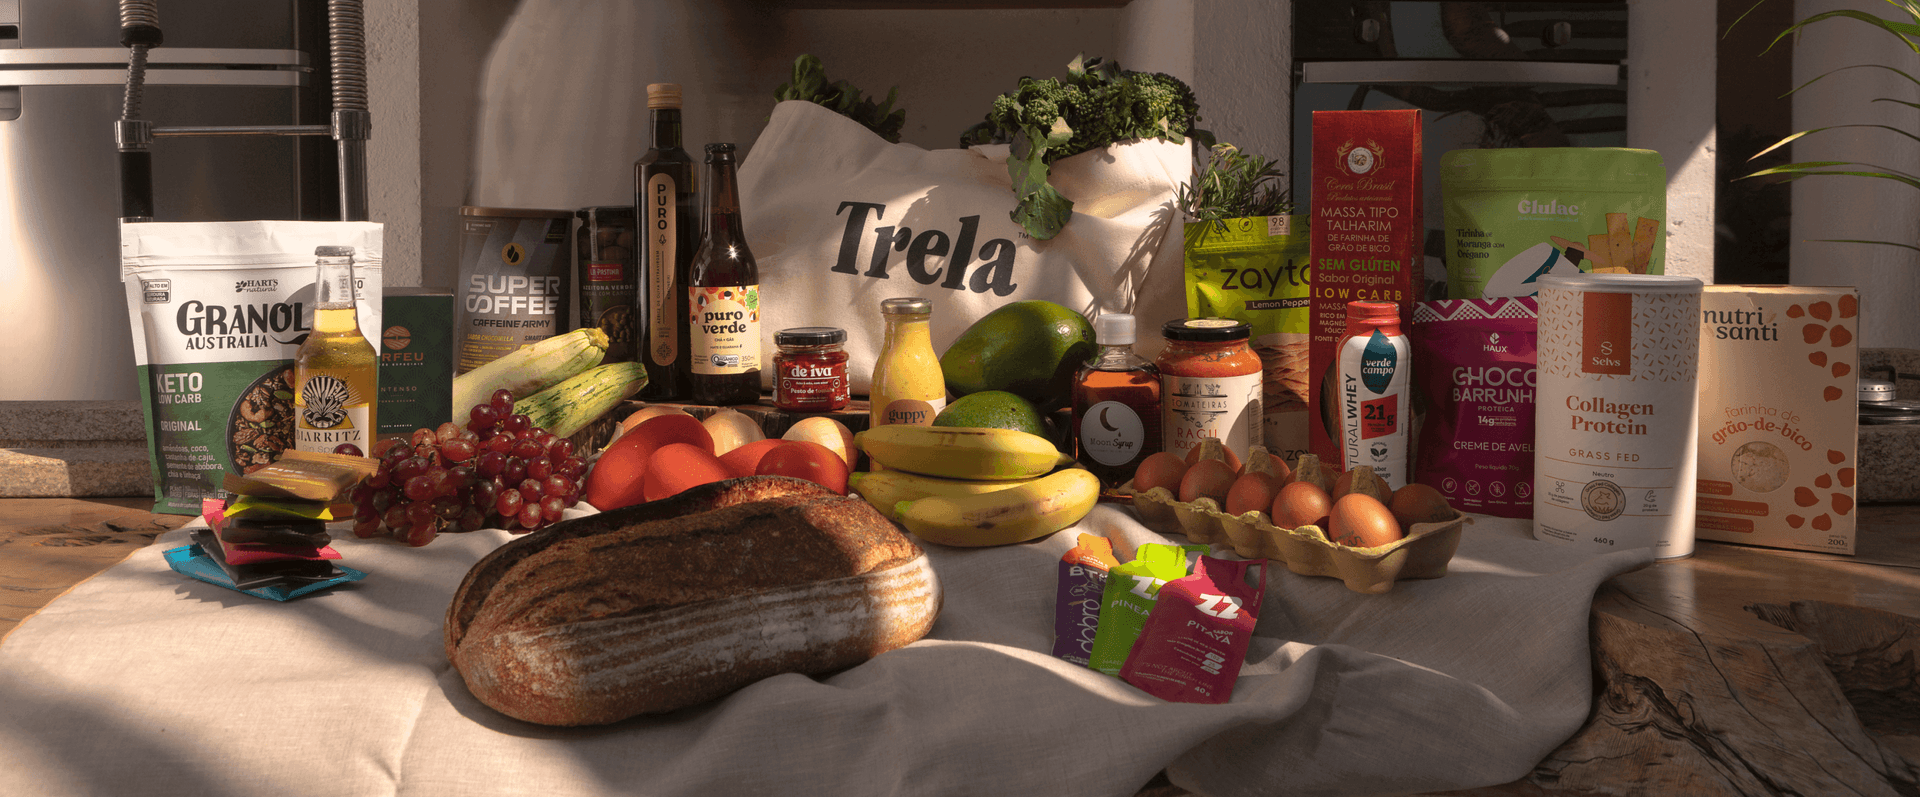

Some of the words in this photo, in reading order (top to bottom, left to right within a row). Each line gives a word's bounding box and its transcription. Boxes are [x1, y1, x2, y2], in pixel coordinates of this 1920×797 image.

[1357, 177, 1395, 190] Brasil
[657, 183, 667, 230] PURO
[1321, 207, 1366, 218] MASSA
[1370, 207, 1398, 218] TIPO
[1518, 199, 1579, 216] Glulac
[1327, 220, 1392, 231] TALHARIM
[1340, 234, 1375, 242] FARINHA
[1456, 229, 1485, 238] Tirinha
[831, 201, 1017, 297] Trela
[1328, 243, 1354, 252] GRÃO
[1457, 239, 1492, 249] Moranga
[1319, 258, 1345, 270] SEM
[1350, 256, 1400, 272] GLÚTEN
[469, 275, 560, 294] SUPER
[1319, 273, 1349, 283] Sabor
[1352, 274, 1395, 286] Original
[1316, 288, 1350, 299] LOW
[1357, 289, 1402, 300] CARB
[466, 295, 559, 315] COFFEE
[1252, 301, 1280, 309] Lemon
[1318, 302, 1347, 310] MASSA
[176, 300, 311, 336] GRANOL
[704, 311, 743, 323] puro
[1703, 307, 1764, 326] nutri
[473, 319, 520, 328] CAFFEINE
[522, 319, 550, 328] ARMY
[702, 321, 746, 334] verde
[1319, 319, 1347, 327] MAGNÉS
[1716, 323, 1778, 341] santi
[186, 335, 268, 350] AUSTRALIA
[382, 352, 424, 362] RFEU
[1365, 358, 1391, 367] verde
[1592, 357, 1621, 366] Selvs
[791, 365, 808, 377] de
[810, 364, 833, 377] iva
[1363, 366, 1394, 376] campo
[156, 372, 203, 393] KETO
[158, 394, 173, 404] LOW
[174, 393, 202, 404] CARB
[1453, 388, 1537, 405] BARRINH
[1172, 398, 1227, 408] TOMATEIRAS
[1566, 395, 1654, 419] Collagen
[889, 409, 928, 423] guppy
[1725, 403, 1777, 419] farinha
[1781, 410, 1800, 424] de
[160, 420, 202, 432] ORIGINAL
[1477, 416, 1495, 426] 14g
[1571, 415, 1648, 435] Protein
[296, 430, 361, 442] BIARRITZ
[1712, 417, 1812, 451] grão-de-bico
[1090, 438, 1111, 446] Moon
[1112, 438, 1133, 449] Syrup
[1453, 441, 1489, 450] CREME
[1492, 443, 1506, 451] DE
[1508, 443, 1536, 452] AVEL
[198, 453, 215, 463] caju,
[1569, 448, 1611, 460] GRASS
[1616, 453, 1640, 462] FED
[194, 461, 224, 470] abóbora,
[1593, 536, 1608, 544] 460
[1828, 538, 1848, 546] 200g
[1111, 599, 1150, 616] PINEA
[1187, 620, 1230, 645] PITAYA
[1195, 686, 1205, 694] 40
